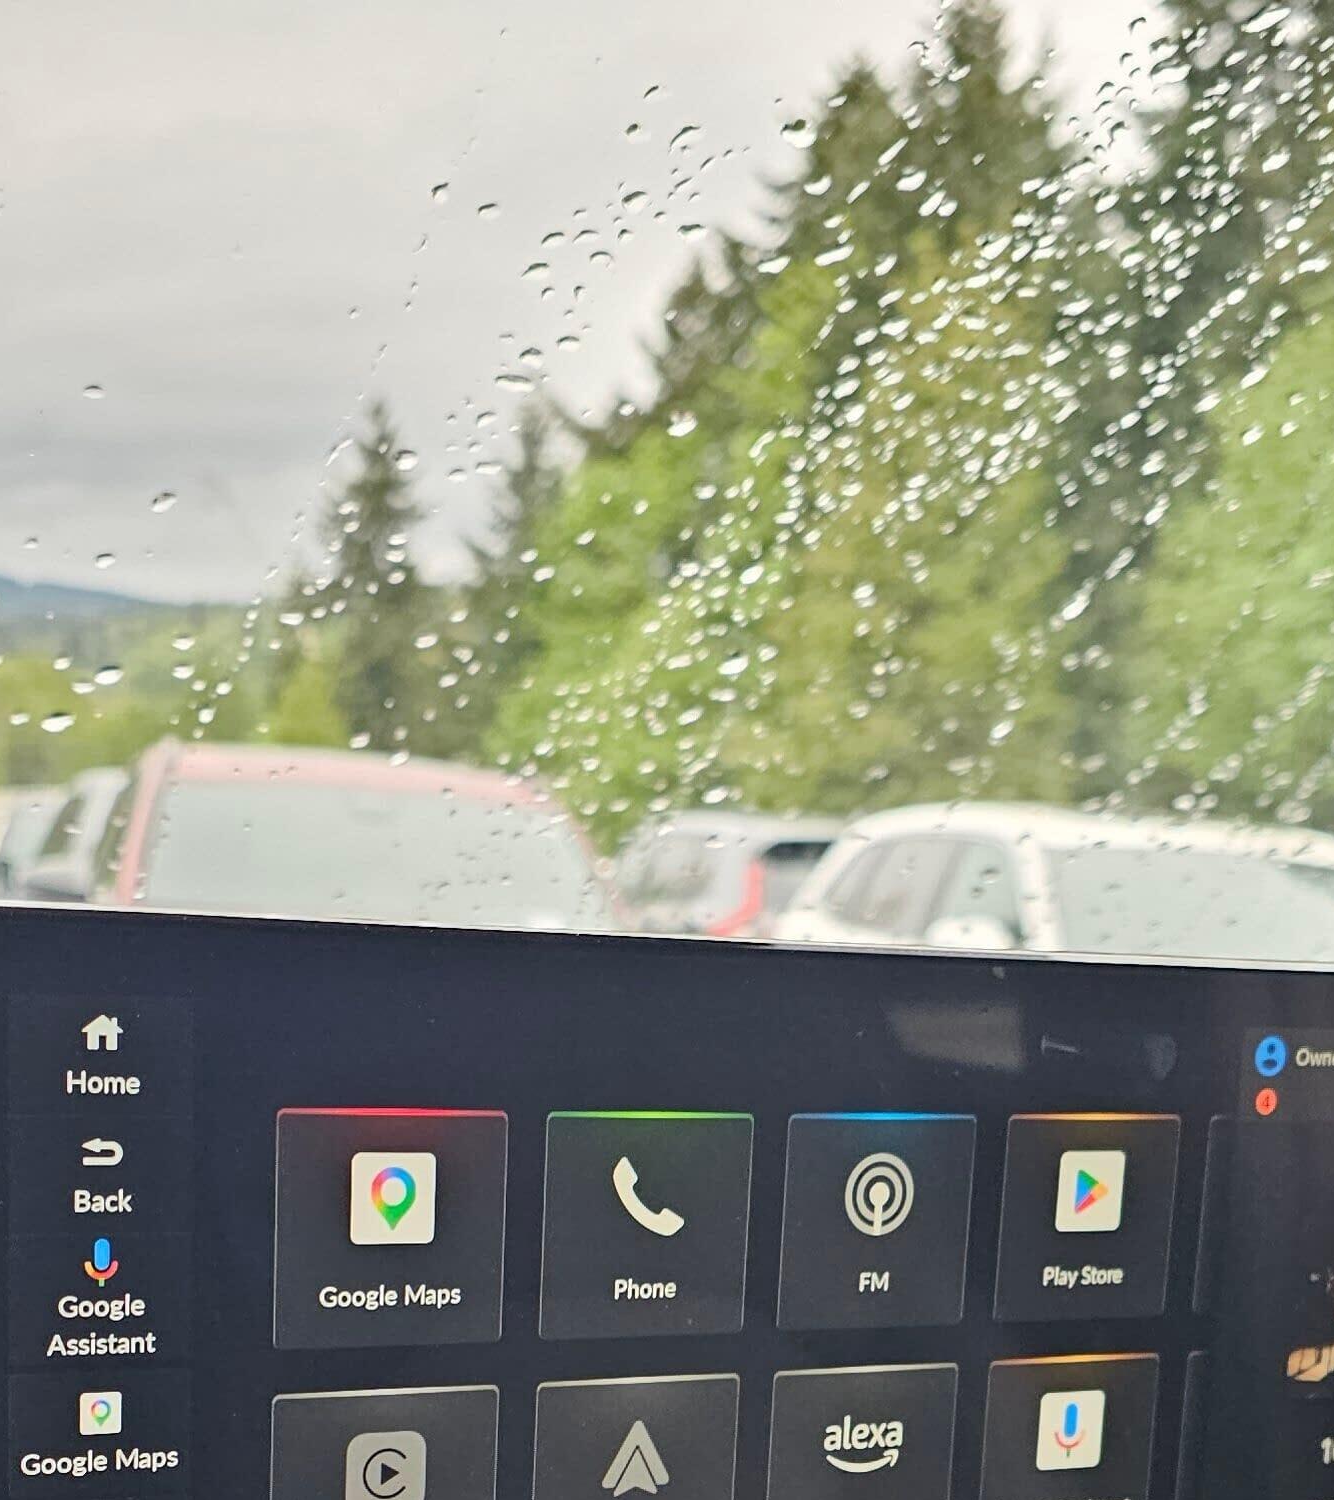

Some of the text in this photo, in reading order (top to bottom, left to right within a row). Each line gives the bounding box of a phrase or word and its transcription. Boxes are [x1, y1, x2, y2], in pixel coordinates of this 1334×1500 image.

[66, 1069, 141, 1096] Home
[73, 1188, 133, 1214] Back
[613, 1278, 677, 1300] Phone
[858, 1272, 890, 1293] FM
[1042, 1265, 1124, 1288] Play Store
[57, 1295, 146, 1320] Google
[319, 1284, 462, 1310] Google Maps
[46, 1332, 156, 1358] Assistant
[824, 1416, 904, 1451] alexa
[20, 1449, 179, 1478] Google Maps
